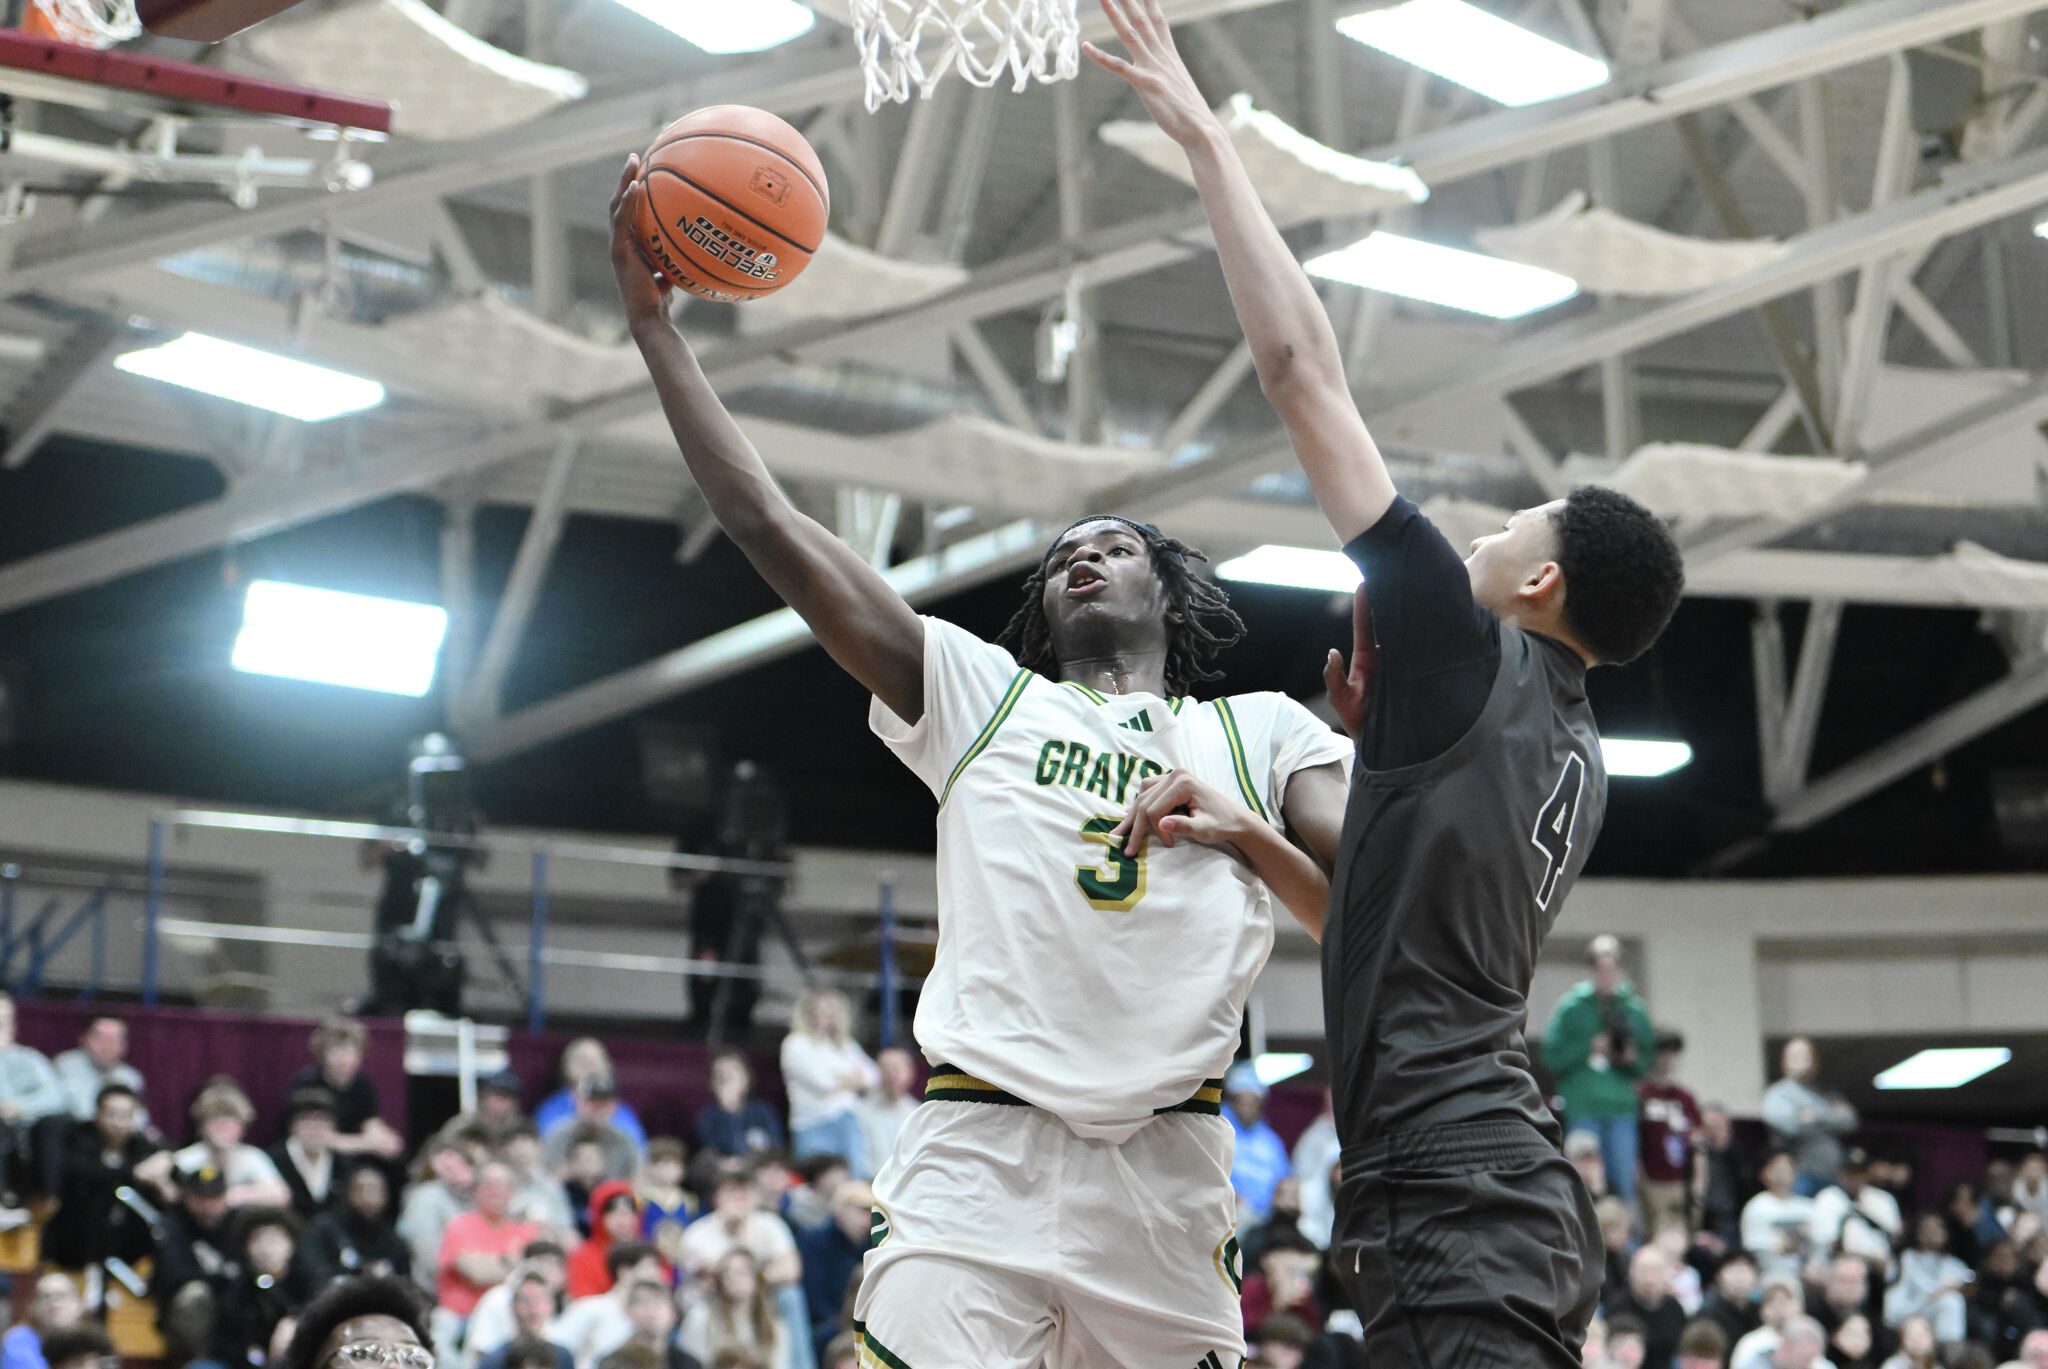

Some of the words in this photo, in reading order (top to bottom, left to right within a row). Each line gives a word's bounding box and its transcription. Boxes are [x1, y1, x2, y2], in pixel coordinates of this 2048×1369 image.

[650, 234, 759, 301] ALDING
[676, 216, 782, 281] PRECISION
[695, 216, 757, 259] 1000
[1035, 739, 1173, 804] GRAY
[1074, 813, 1147, 912] 3
[1532, 751, 1585, 911] 4
